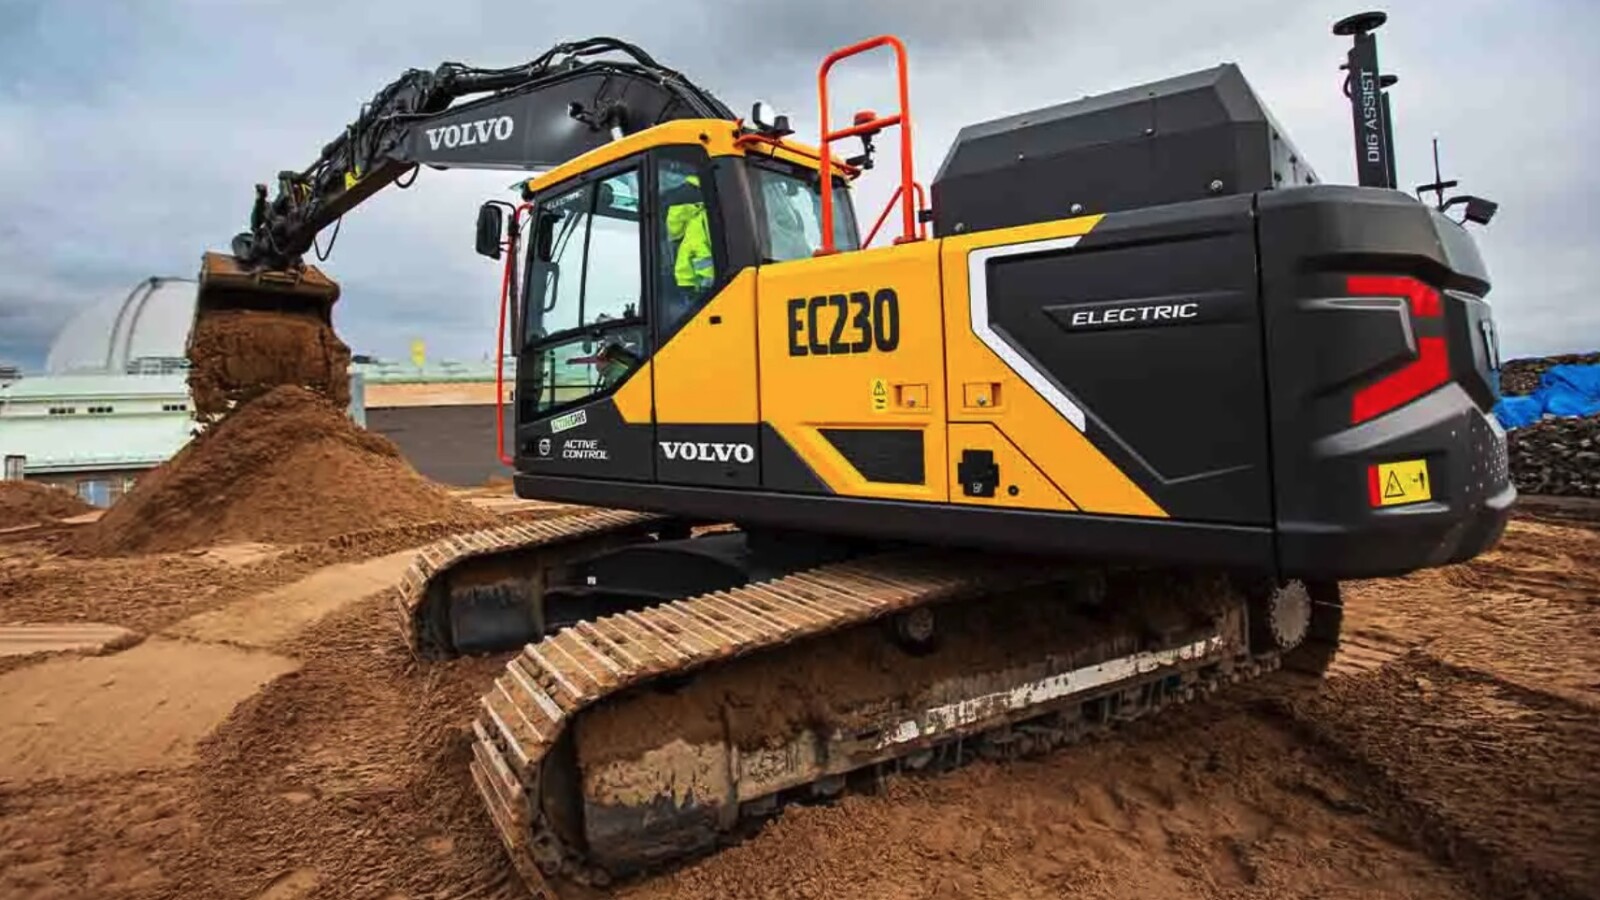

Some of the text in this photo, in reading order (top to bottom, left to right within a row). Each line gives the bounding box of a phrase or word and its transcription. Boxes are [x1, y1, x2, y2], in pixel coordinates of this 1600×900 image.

[1360, 69, 1380, 163] DIG ASSIST
[425, 116, 514, 151] VOLVO
[787, 288, 900, 357] EC230
[1072, 303, 1199, 326] ELECTRIC
[562, 450, 608, 460] CONTROL
[563, 440, 598, 449] ACTIVE
[659, 441, 754, 464] VOLVO
